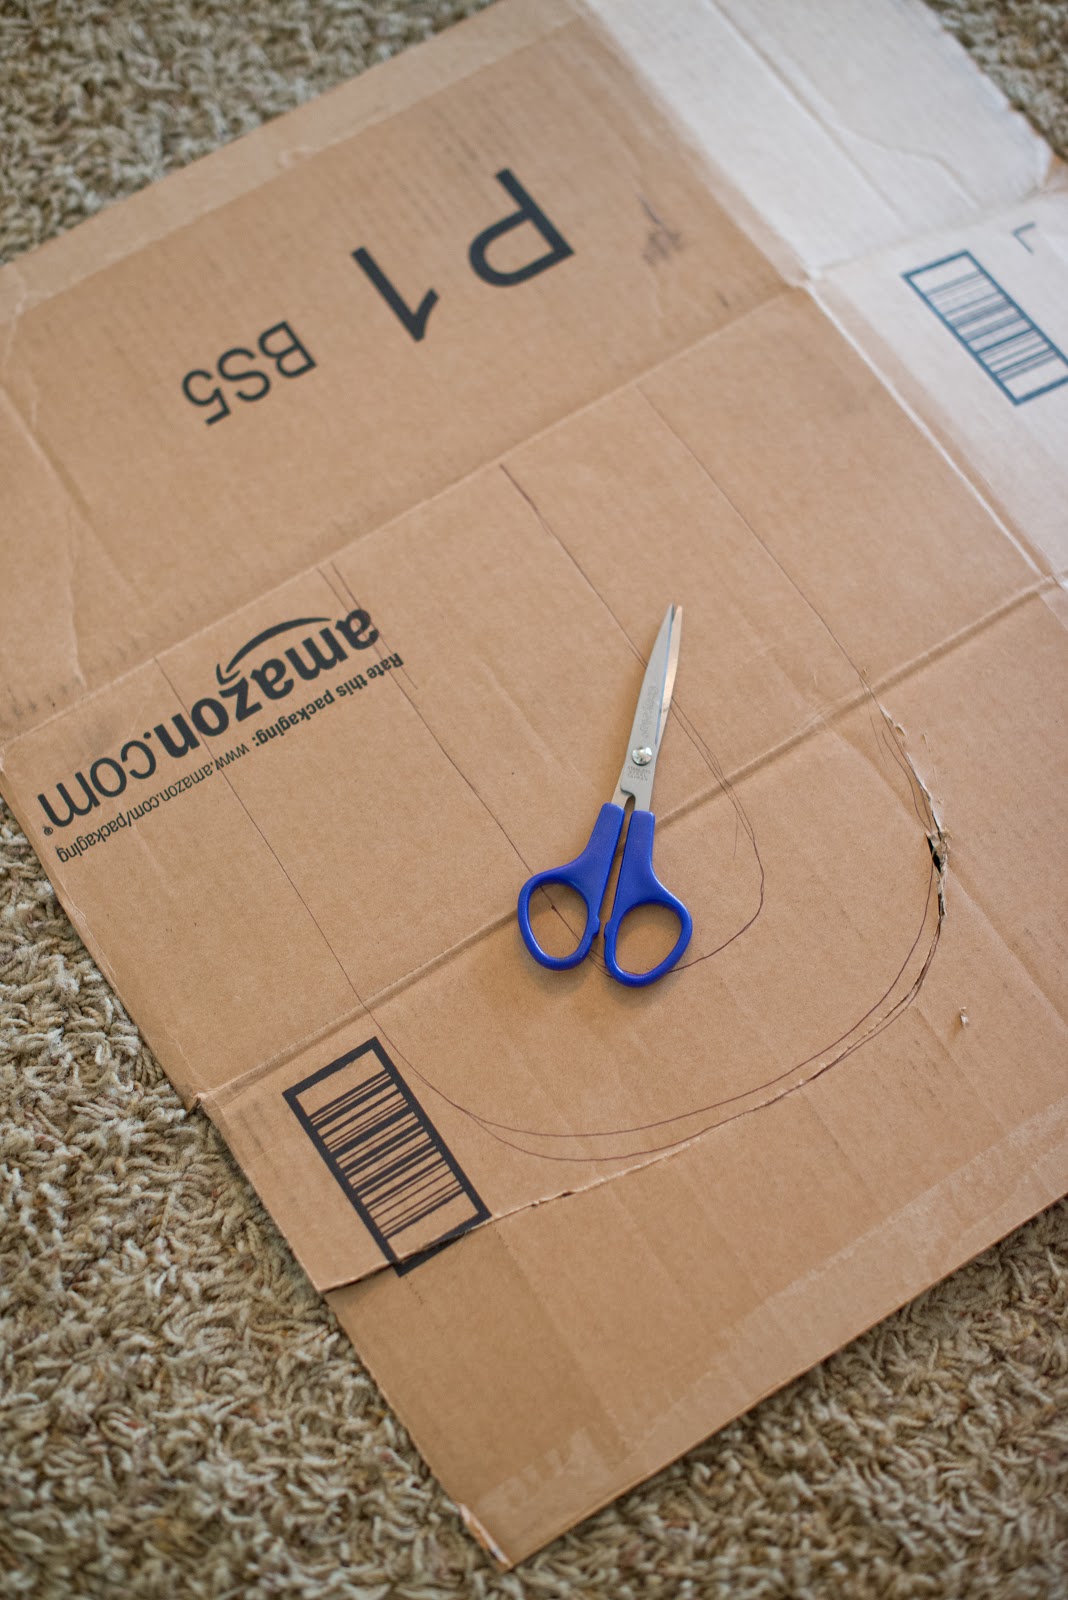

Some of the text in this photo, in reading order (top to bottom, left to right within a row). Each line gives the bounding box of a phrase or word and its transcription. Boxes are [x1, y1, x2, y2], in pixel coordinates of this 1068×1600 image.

[182, 321, 318, 427] BS5
[56, 652, 404, 863] Rate this packaging: www.amazon.com/packaging
